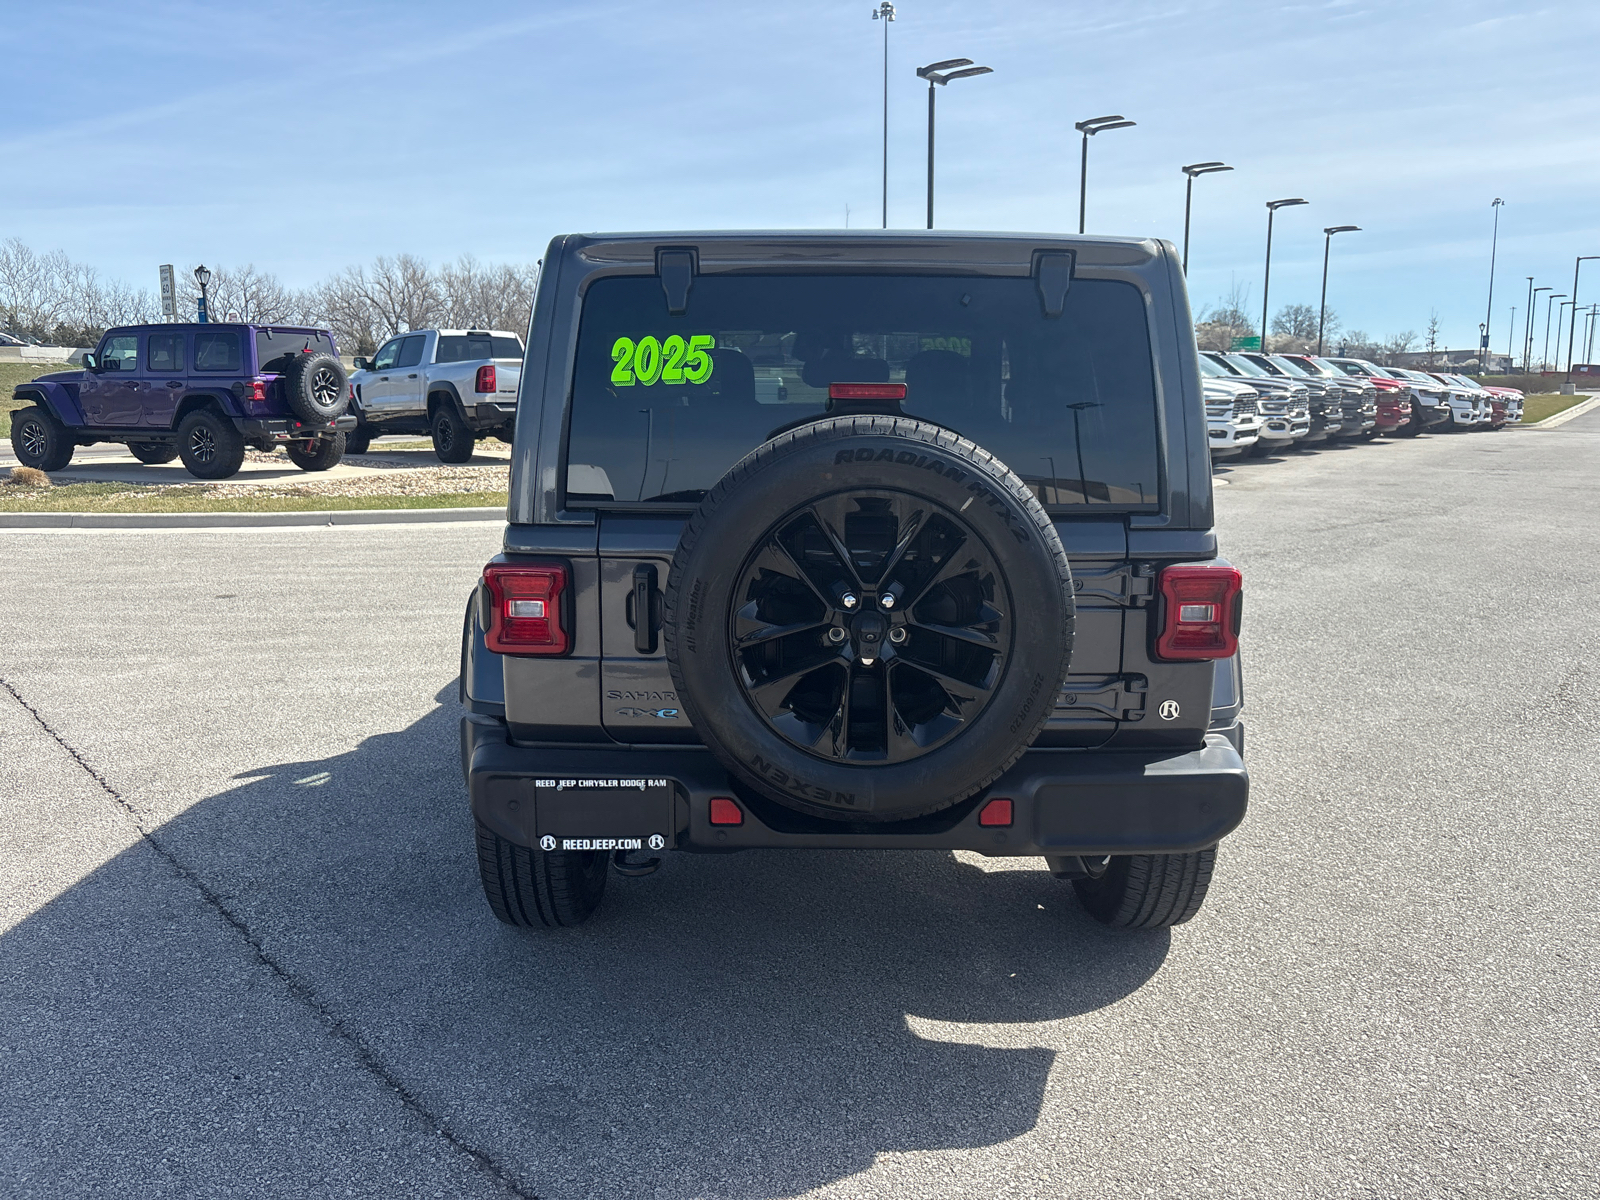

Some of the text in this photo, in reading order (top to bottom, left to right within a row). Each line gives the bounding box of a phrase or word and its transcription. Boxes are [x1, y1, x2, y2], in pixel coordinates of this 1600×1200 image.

[162, 283, 170, 294] 60
[611, 335, 715, 387] 2025
[834, 447, 968, 483] ROADIAN
[606, 690, 679, 701] SAHAR
[535, 779, 556, 788] REED
[559, 779, 577, 788] JEEP
[578, 779, 619, 788] CHRYSLER
[647, 779, 667, 788] RAM
[751, 754, 856, 806] NEXEN
[562, 838, 642, 850] REEDJEEP.COM
